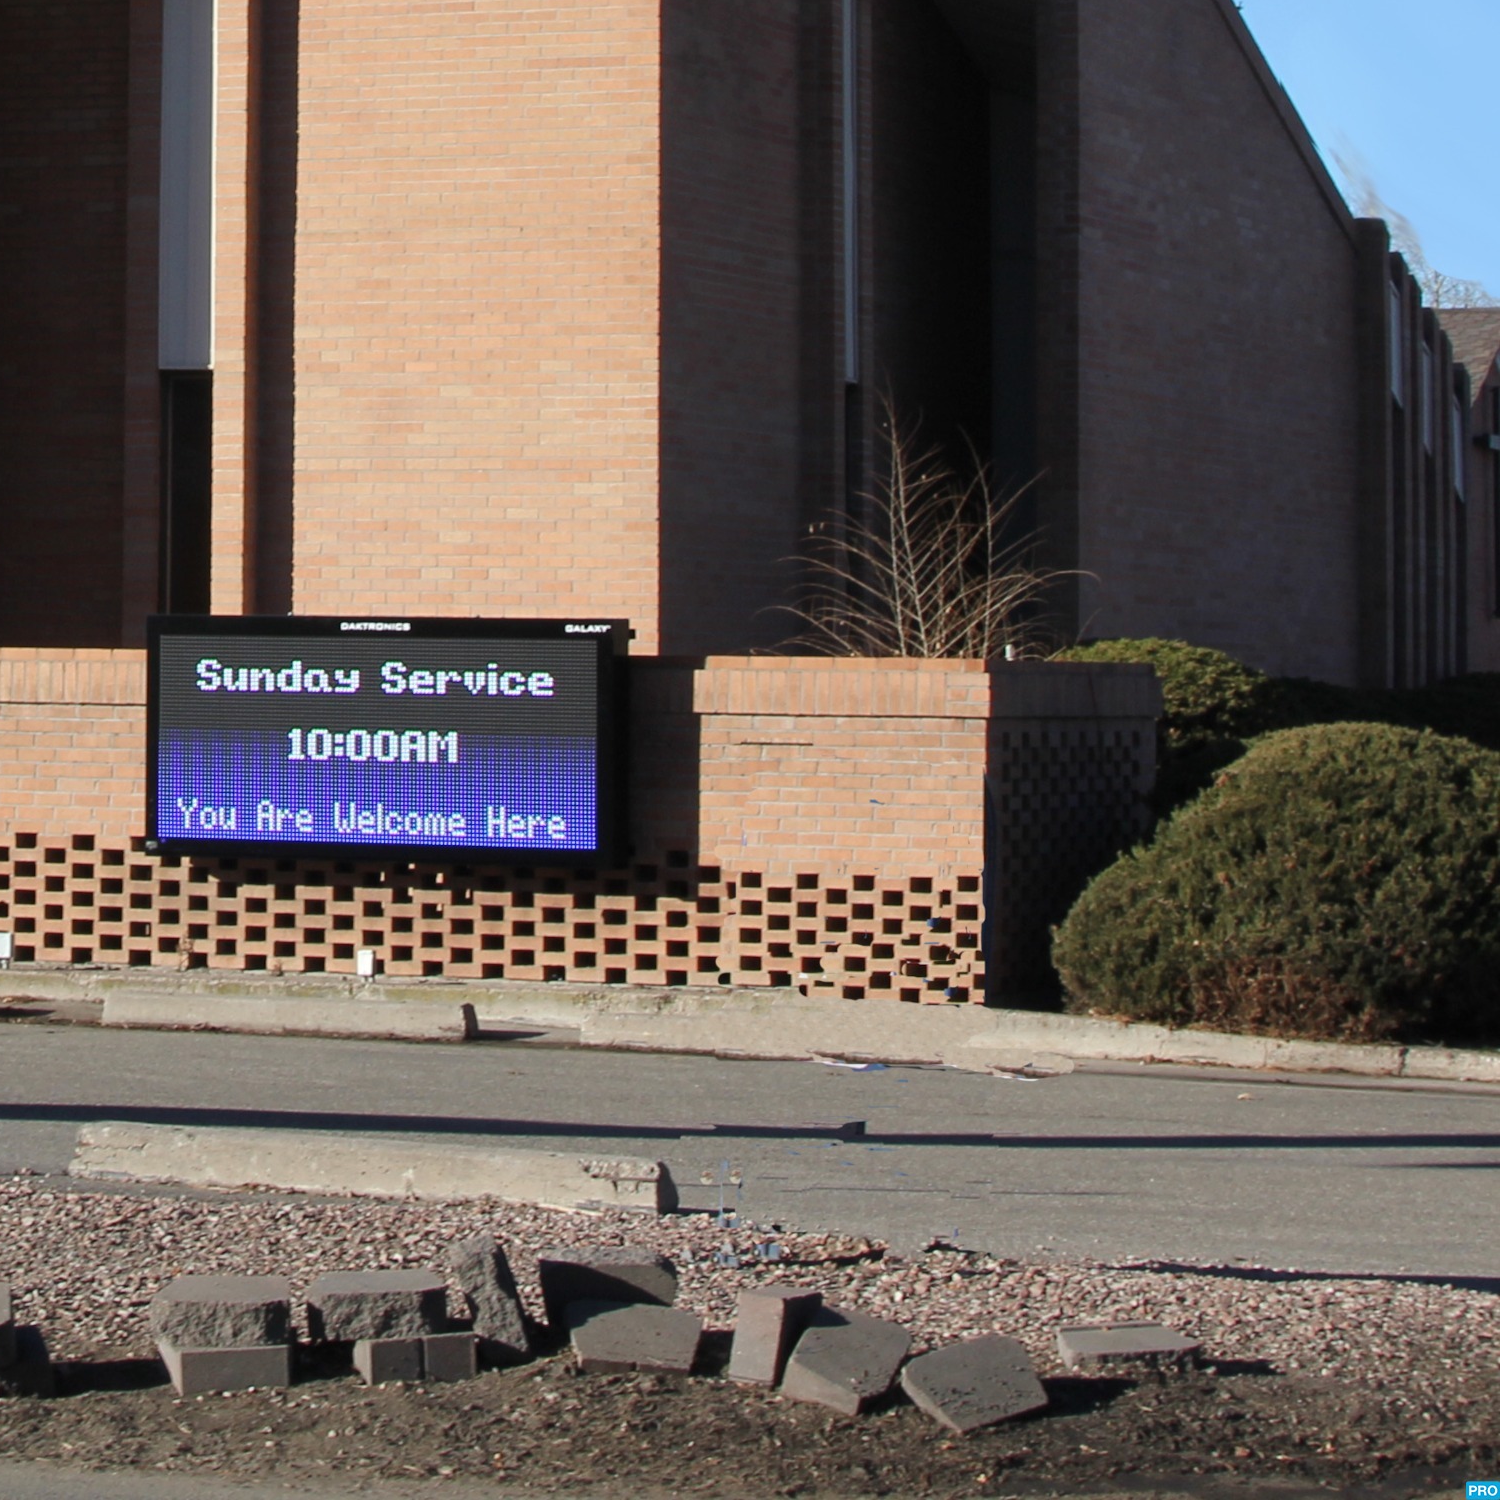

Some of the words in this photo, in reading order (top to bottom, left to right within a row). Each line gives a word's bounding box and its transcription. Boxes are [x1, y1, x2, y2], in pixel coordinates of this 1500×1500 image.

[340, 622, 411, 632] DAKTRONICS
[196, 658, 361, 694] Sunday
[380, 661, 555, 697] Service
[287, 728, 460, 763] 10:00AM
[177, 797, 237, 832] You
[257, 800, 314, 833] Are
[334, 802, 466, 837] Welcome
[487, 805, 567, 840] Here
